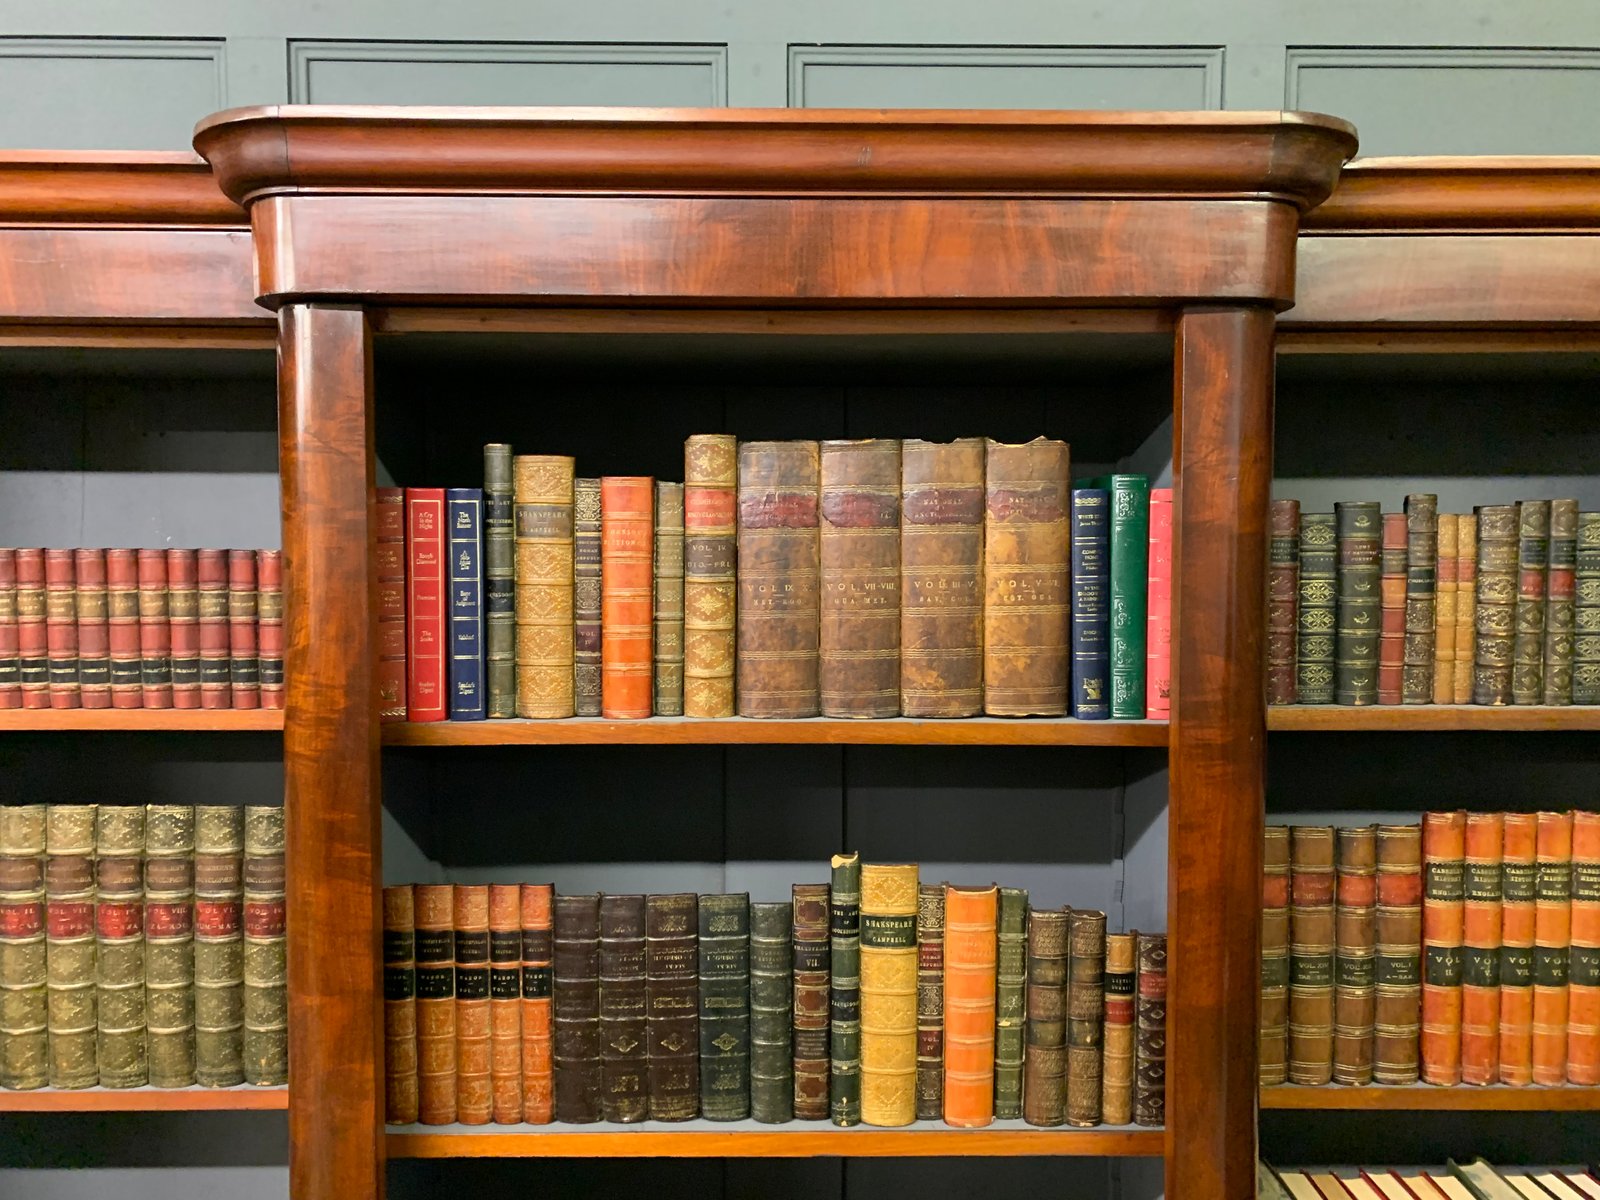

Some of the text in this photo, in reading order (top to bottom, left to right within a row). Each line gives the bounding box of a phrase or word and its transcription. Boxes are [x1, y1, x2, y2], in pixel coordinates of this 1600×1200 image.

[826, 583, 860, 591] VOL.
[997, 579, 1031, 588] VOL.
[865, 919, 913, 928] SHAKSPEARE
[1435, 956, 1460, 964] VOL
